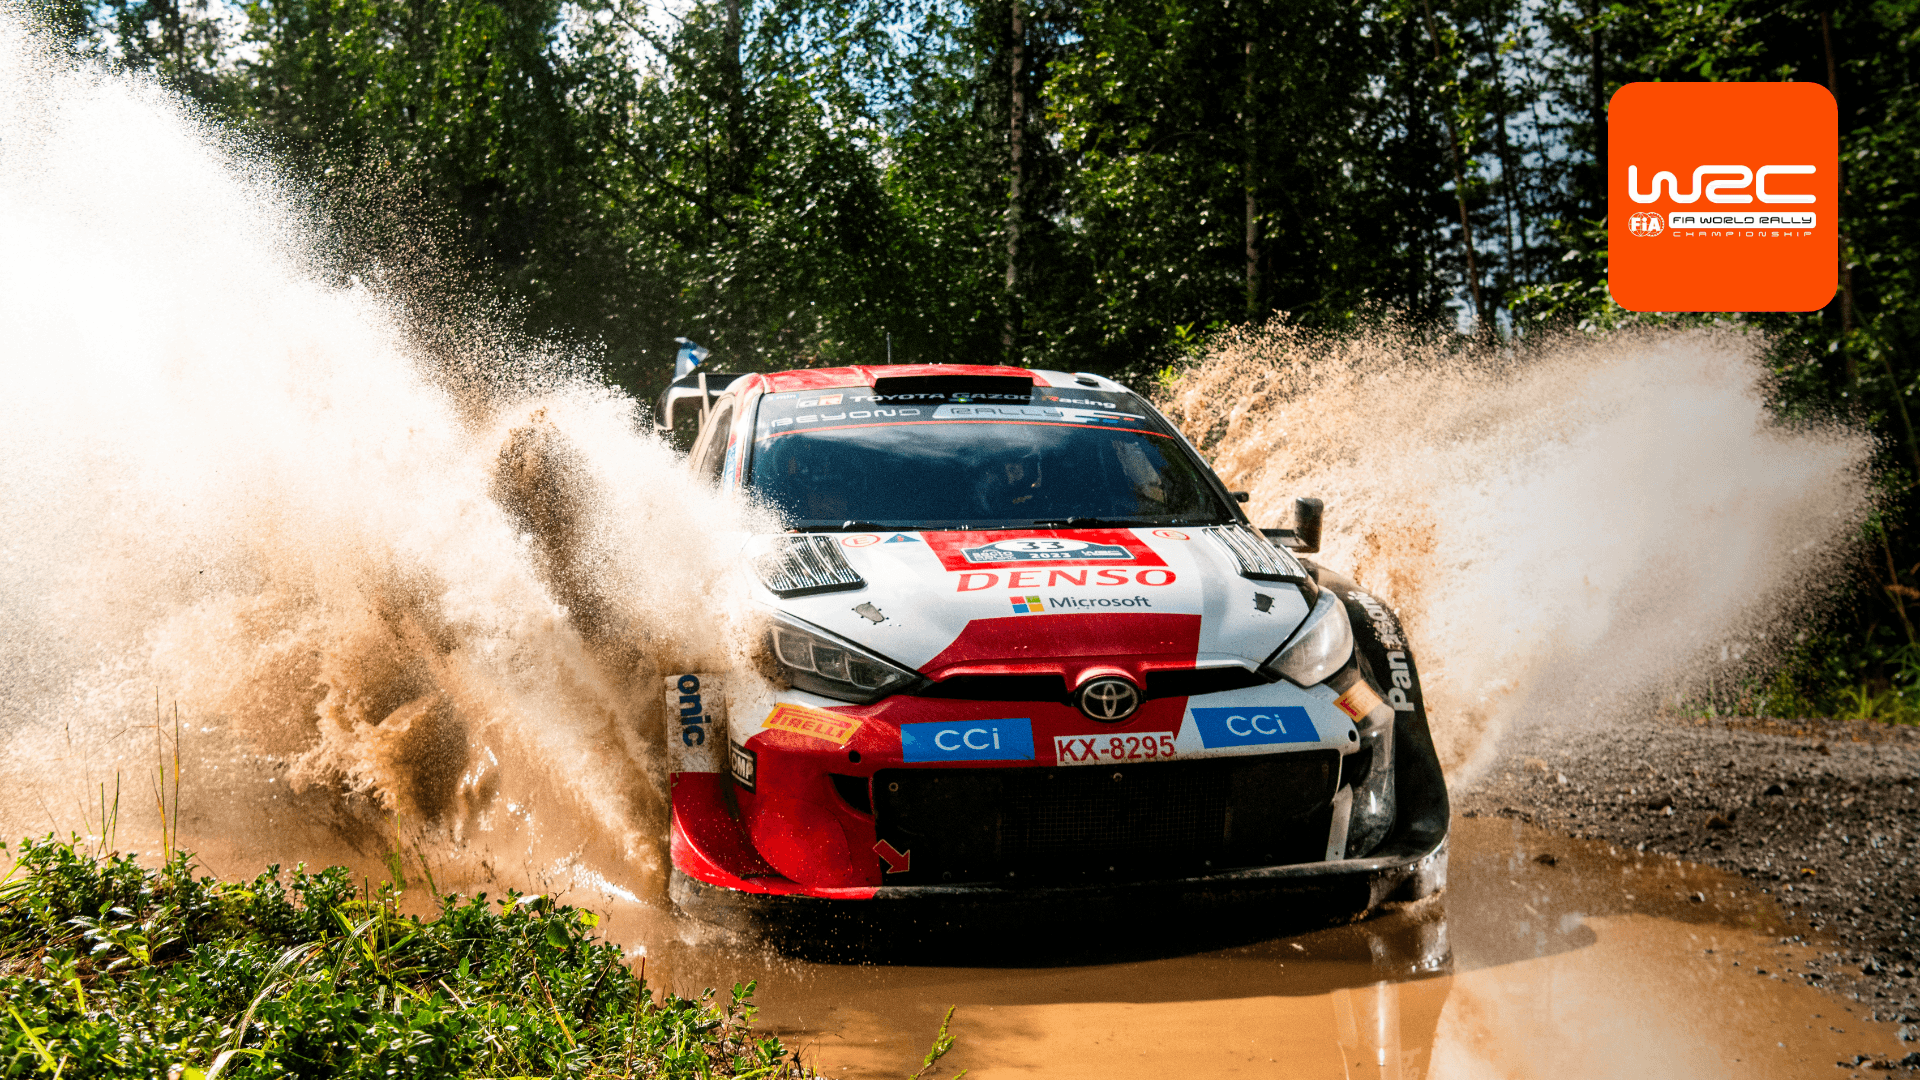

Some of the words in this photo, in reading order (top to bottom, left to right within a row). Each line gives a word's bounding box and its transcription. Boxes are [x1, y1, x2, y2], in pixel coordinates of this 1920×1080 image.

[850, 393, 945, 402] TOYOTA
[771, 408, 920, 427] BEYOND
[950, 407, 1064, 417] RALLY
[1017, 541, 1065, 550] 33
[957, 569, 1176, 592] DENSO
[1049, 596, 1152, 608] Microsoft
[770, 707, 852, 739] PIRELLI
[1058, 735, 1175, 762] KX-8295
[732, 752, 754, 780] OMP
